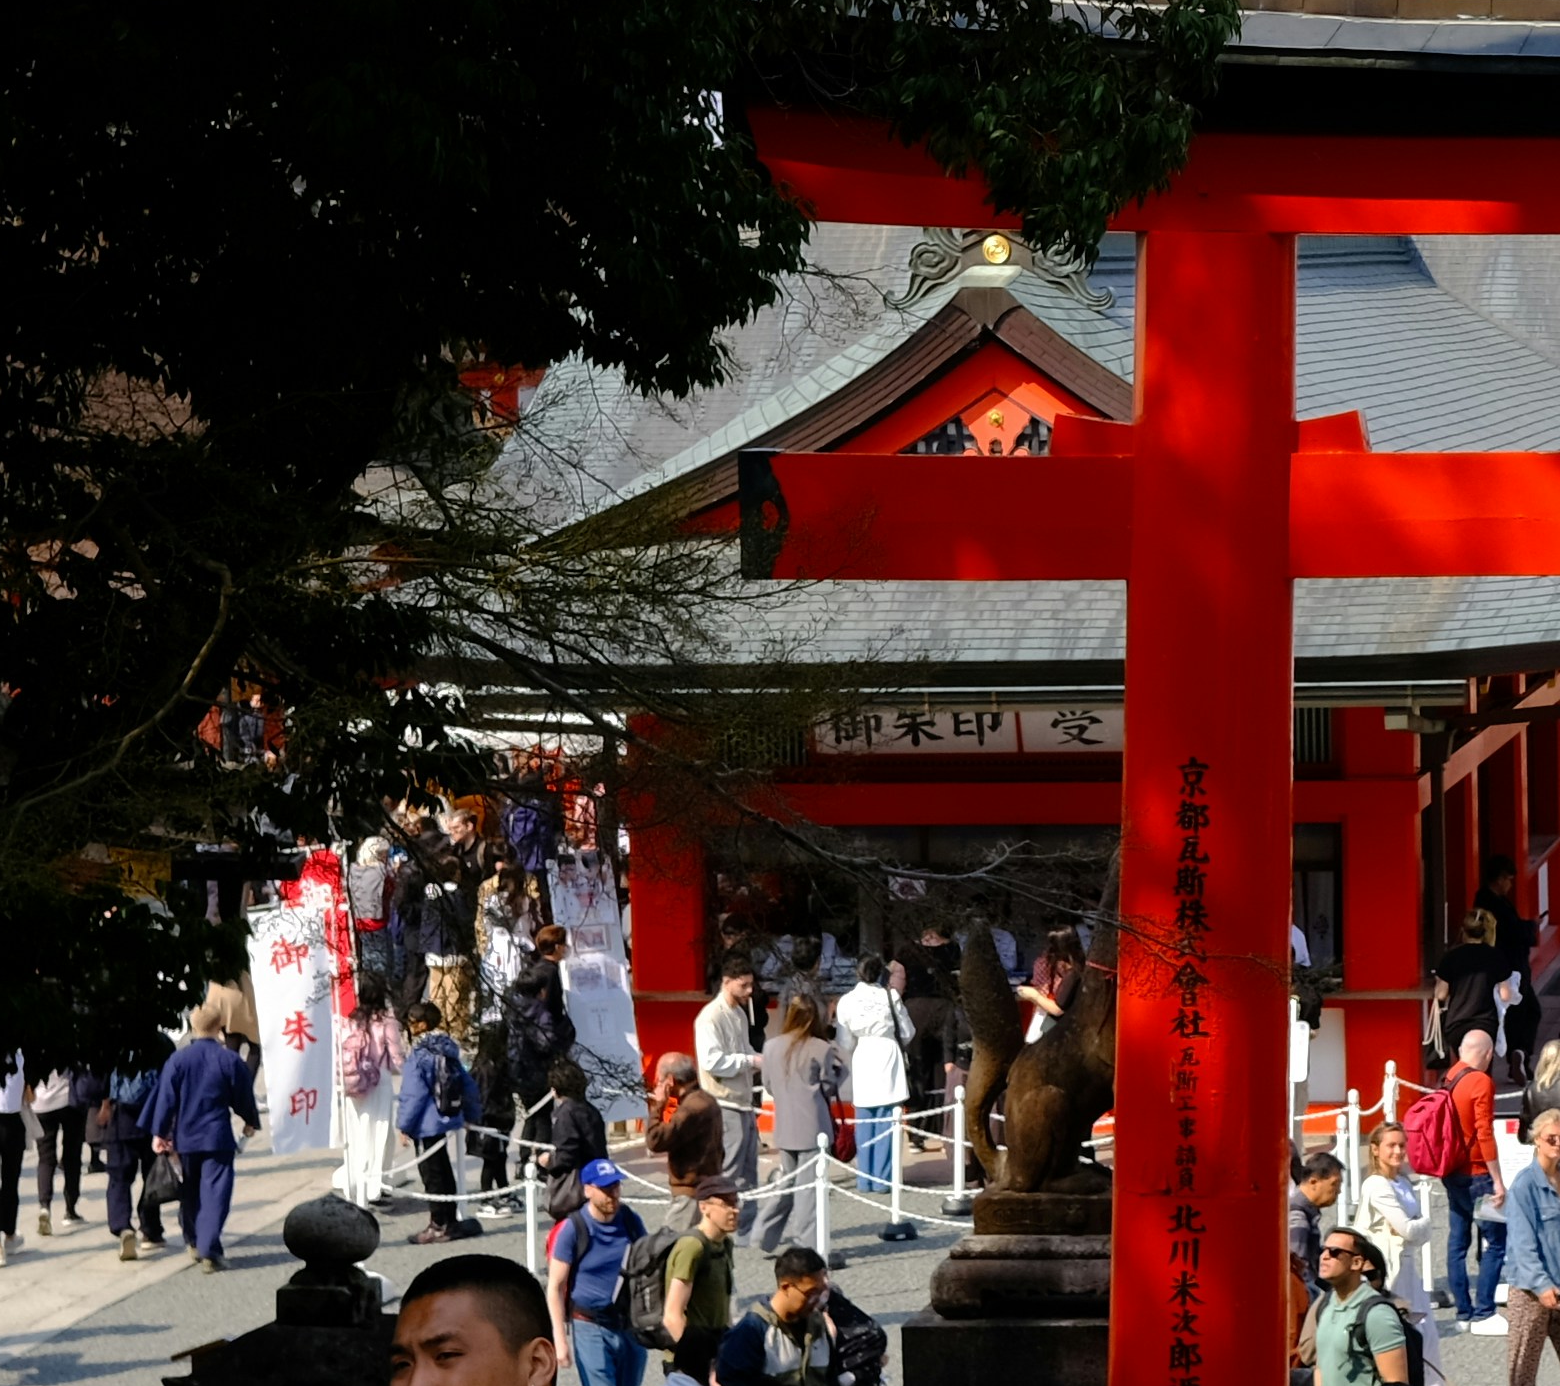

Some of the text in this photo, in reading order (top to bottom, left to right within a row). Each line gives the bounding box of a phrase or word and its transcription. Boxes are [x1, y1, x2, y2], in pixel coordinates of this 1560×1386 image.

[831, 710, 1007, 748] 御朱印
[270, 934, 318, 1126] 御朱印
